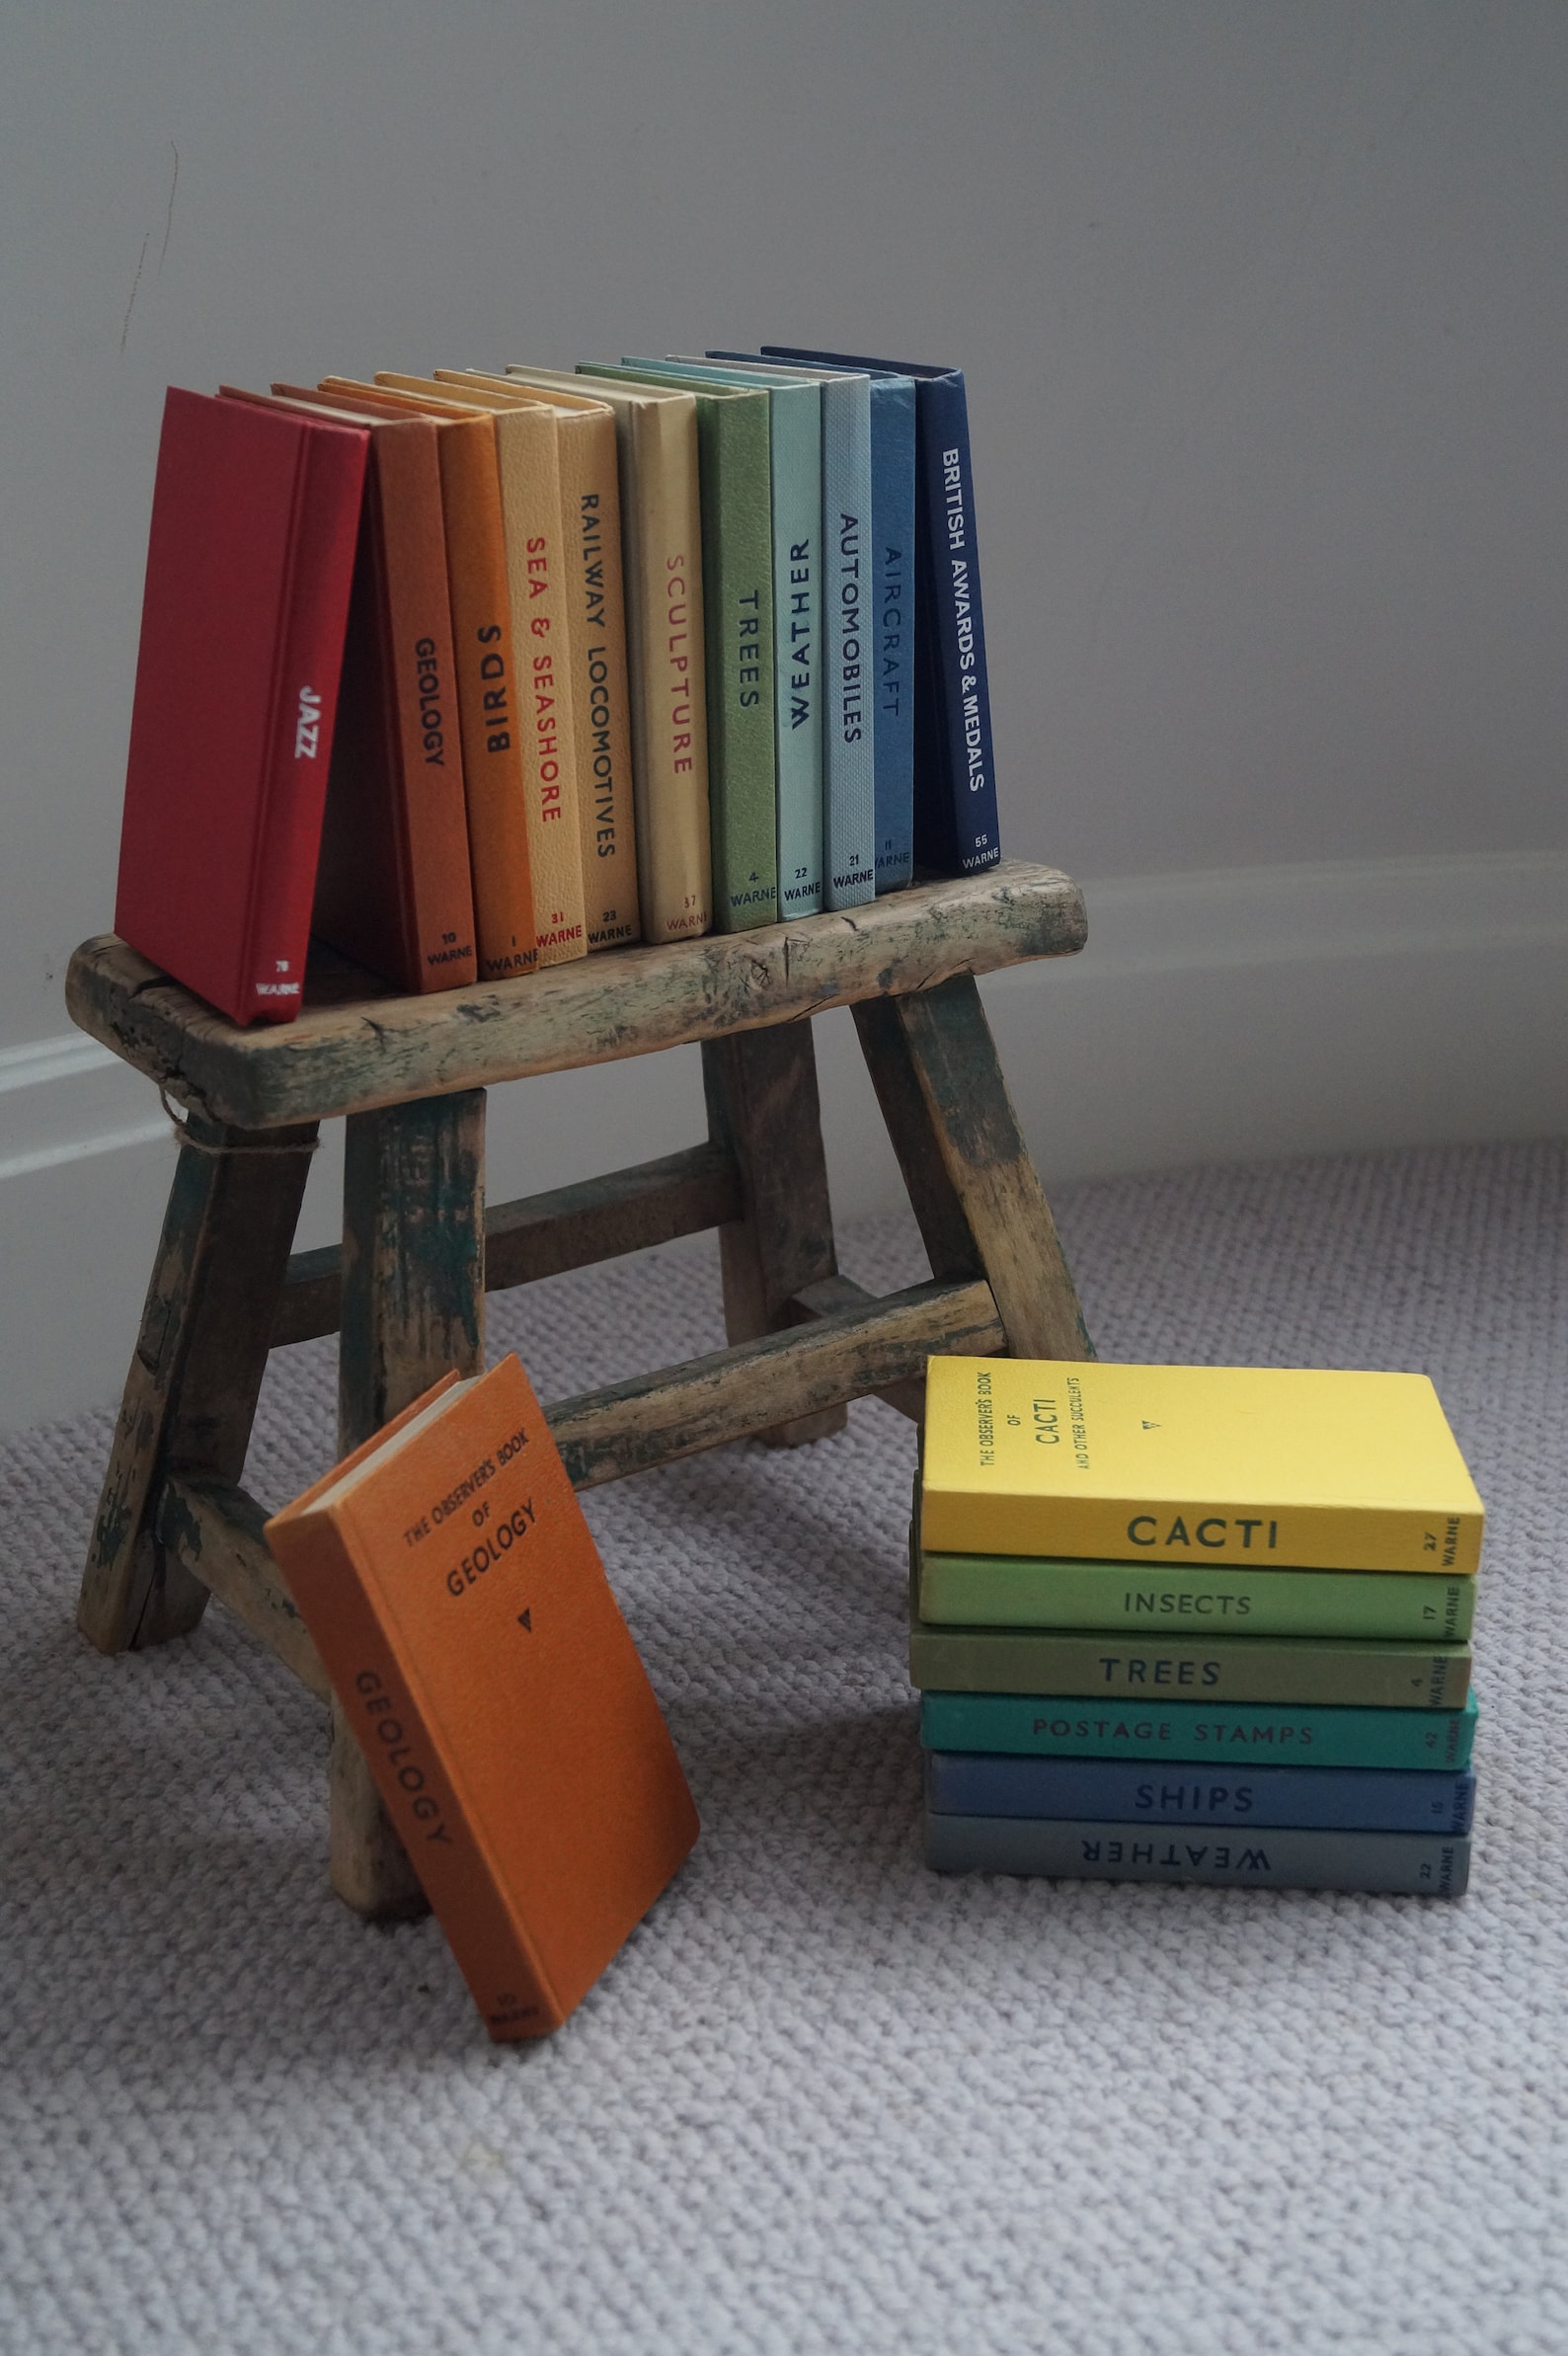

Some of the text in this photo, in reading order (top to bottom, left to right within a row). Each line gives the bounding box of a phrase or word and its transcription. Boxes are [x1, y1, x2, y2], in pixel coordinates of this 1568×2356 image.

[839, 513, 862, 744] AUTOMOBILES
[882, 547, 902, 717] AIRCRAFT
[942, 448, 985, 792] BRITISH AWARDS & MEDALS
[739, 589, 759, 707] TREES
[792, 539, 810, 730] WEATHER
[581, 494, 615, 859] RAILWAY LOCOMOTIVES
[667, 555, 692, 774] SCULPTURE
[477, 624, 511, 753] BIRDS
[526, 537, 561, 823] SEA & SEASHORE
[415, 638, 444, 767] GEOLOGY
[295, 685, 322, 759] JAZZ
[975, 834, 987, 847] 55
[849, 854, 859, 866] 21
[962, 847, 999, 869] WARNE
[748, 872, 759, 883] 4
[795, 868, 808, 879] 22
[833, 869, 874, 889] WARNE
[684, 896, 696, 908] 37
[731, 887, 776, 907] WARNE
[784, 882, 821, 901] WARNE
[551, 912, 564, 924] 31
[602, 910, 617, 922] 23
[441, 932, 456, 945] 10
[536, 924, 583, 948] WARNE
[588, 924, 633, 944] WARNE
[428, 945, 473, 966] WARNE
[487, 948, 538, 973] WARNE
[976, 1372, 994, 1465] THE OBSERVER'S BOOK
[1007, 1414, 1021, 1426] OF
[1033, 1399, 1059, 1445] CACTI
[1066, 1377, 1090, 1469] AND OTHER SUCCULENTS
[402, 1428, 529, 1547] THE OBSERVER'S BOOK
[472, 1501, 491, 1527] OF
[1127, 1516, 1278, 1548] CACTI
[1423, 1532, 1438, 1551] 27
[1442, 1517, 1460, 1567] WARNE
[446, 1497, 536, 1597] GEOLOGY
[1124, 1593, 1251, 1614] INSECTS
[1423, 1606, 1437, 1620] 17
[1445, 1587, 1460, 1638] WARNE
[1099, 1658, 1220, 1686] TREES
[1411, 1678, 1423, 1688] 4
[1429, 1655, 1448, 1705] WARNE
[1033, 1718, 1312, 1745] POSTAGE STAMPS
[1446, 1720, 1459, 1763] WARNE
[356, 1670, 453, 1846] GEOLOGY
[1136, 1784, 1253, 1812] SHIPS
[1451, 1782, 1468, 1832] WARNE
[1081, 1841, 1271, 1871] WEATHER
[1420, 1863, 1431, 1879] 22
[1439, 1846, 1454, 1898] WARNE
